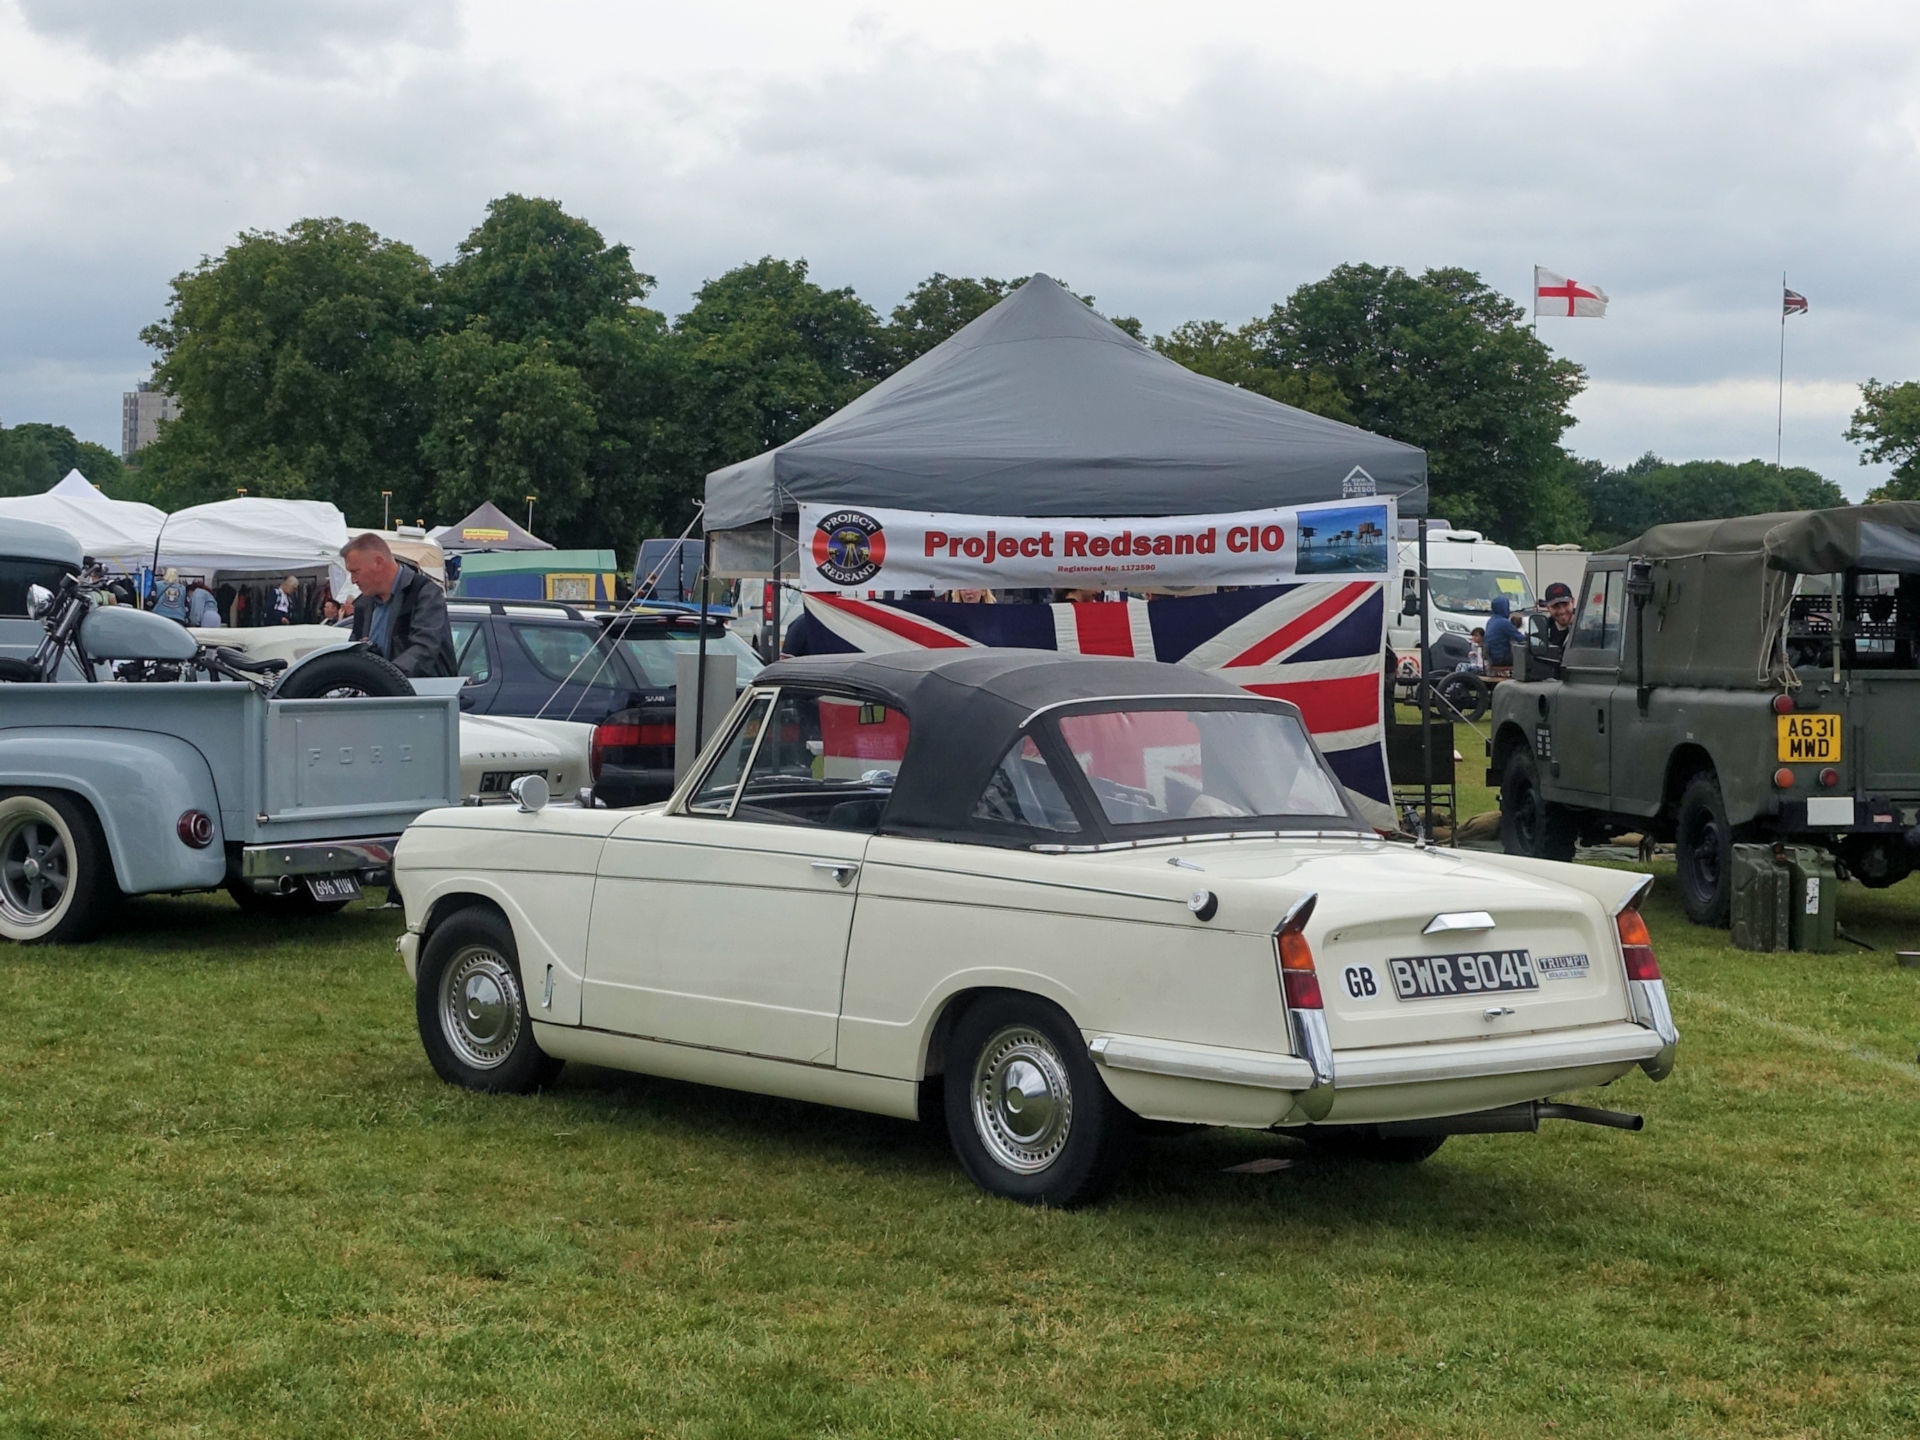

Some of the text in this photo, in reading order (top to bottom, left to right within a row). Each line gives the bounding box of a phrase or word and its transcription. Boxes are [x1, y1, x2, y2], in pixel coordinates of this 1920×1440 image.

[823, 514, 876, 530] PROJECT
[925, 525, 1284, 563] Project Redsand CIO
[822, 563, 876, 581] REDSAND
[1058, 565, 1103, 573] Registered
[1788, 718, 1834, 737] A631
[1790, 738, 1830, 758] MWD
[315, 880, 335, 895] 696
[1540, 955, 1588, 969] TRIUMPH
[1345, 967, 1377, 998] GB
[1392, 952, 1538, 996] BWR 904H
